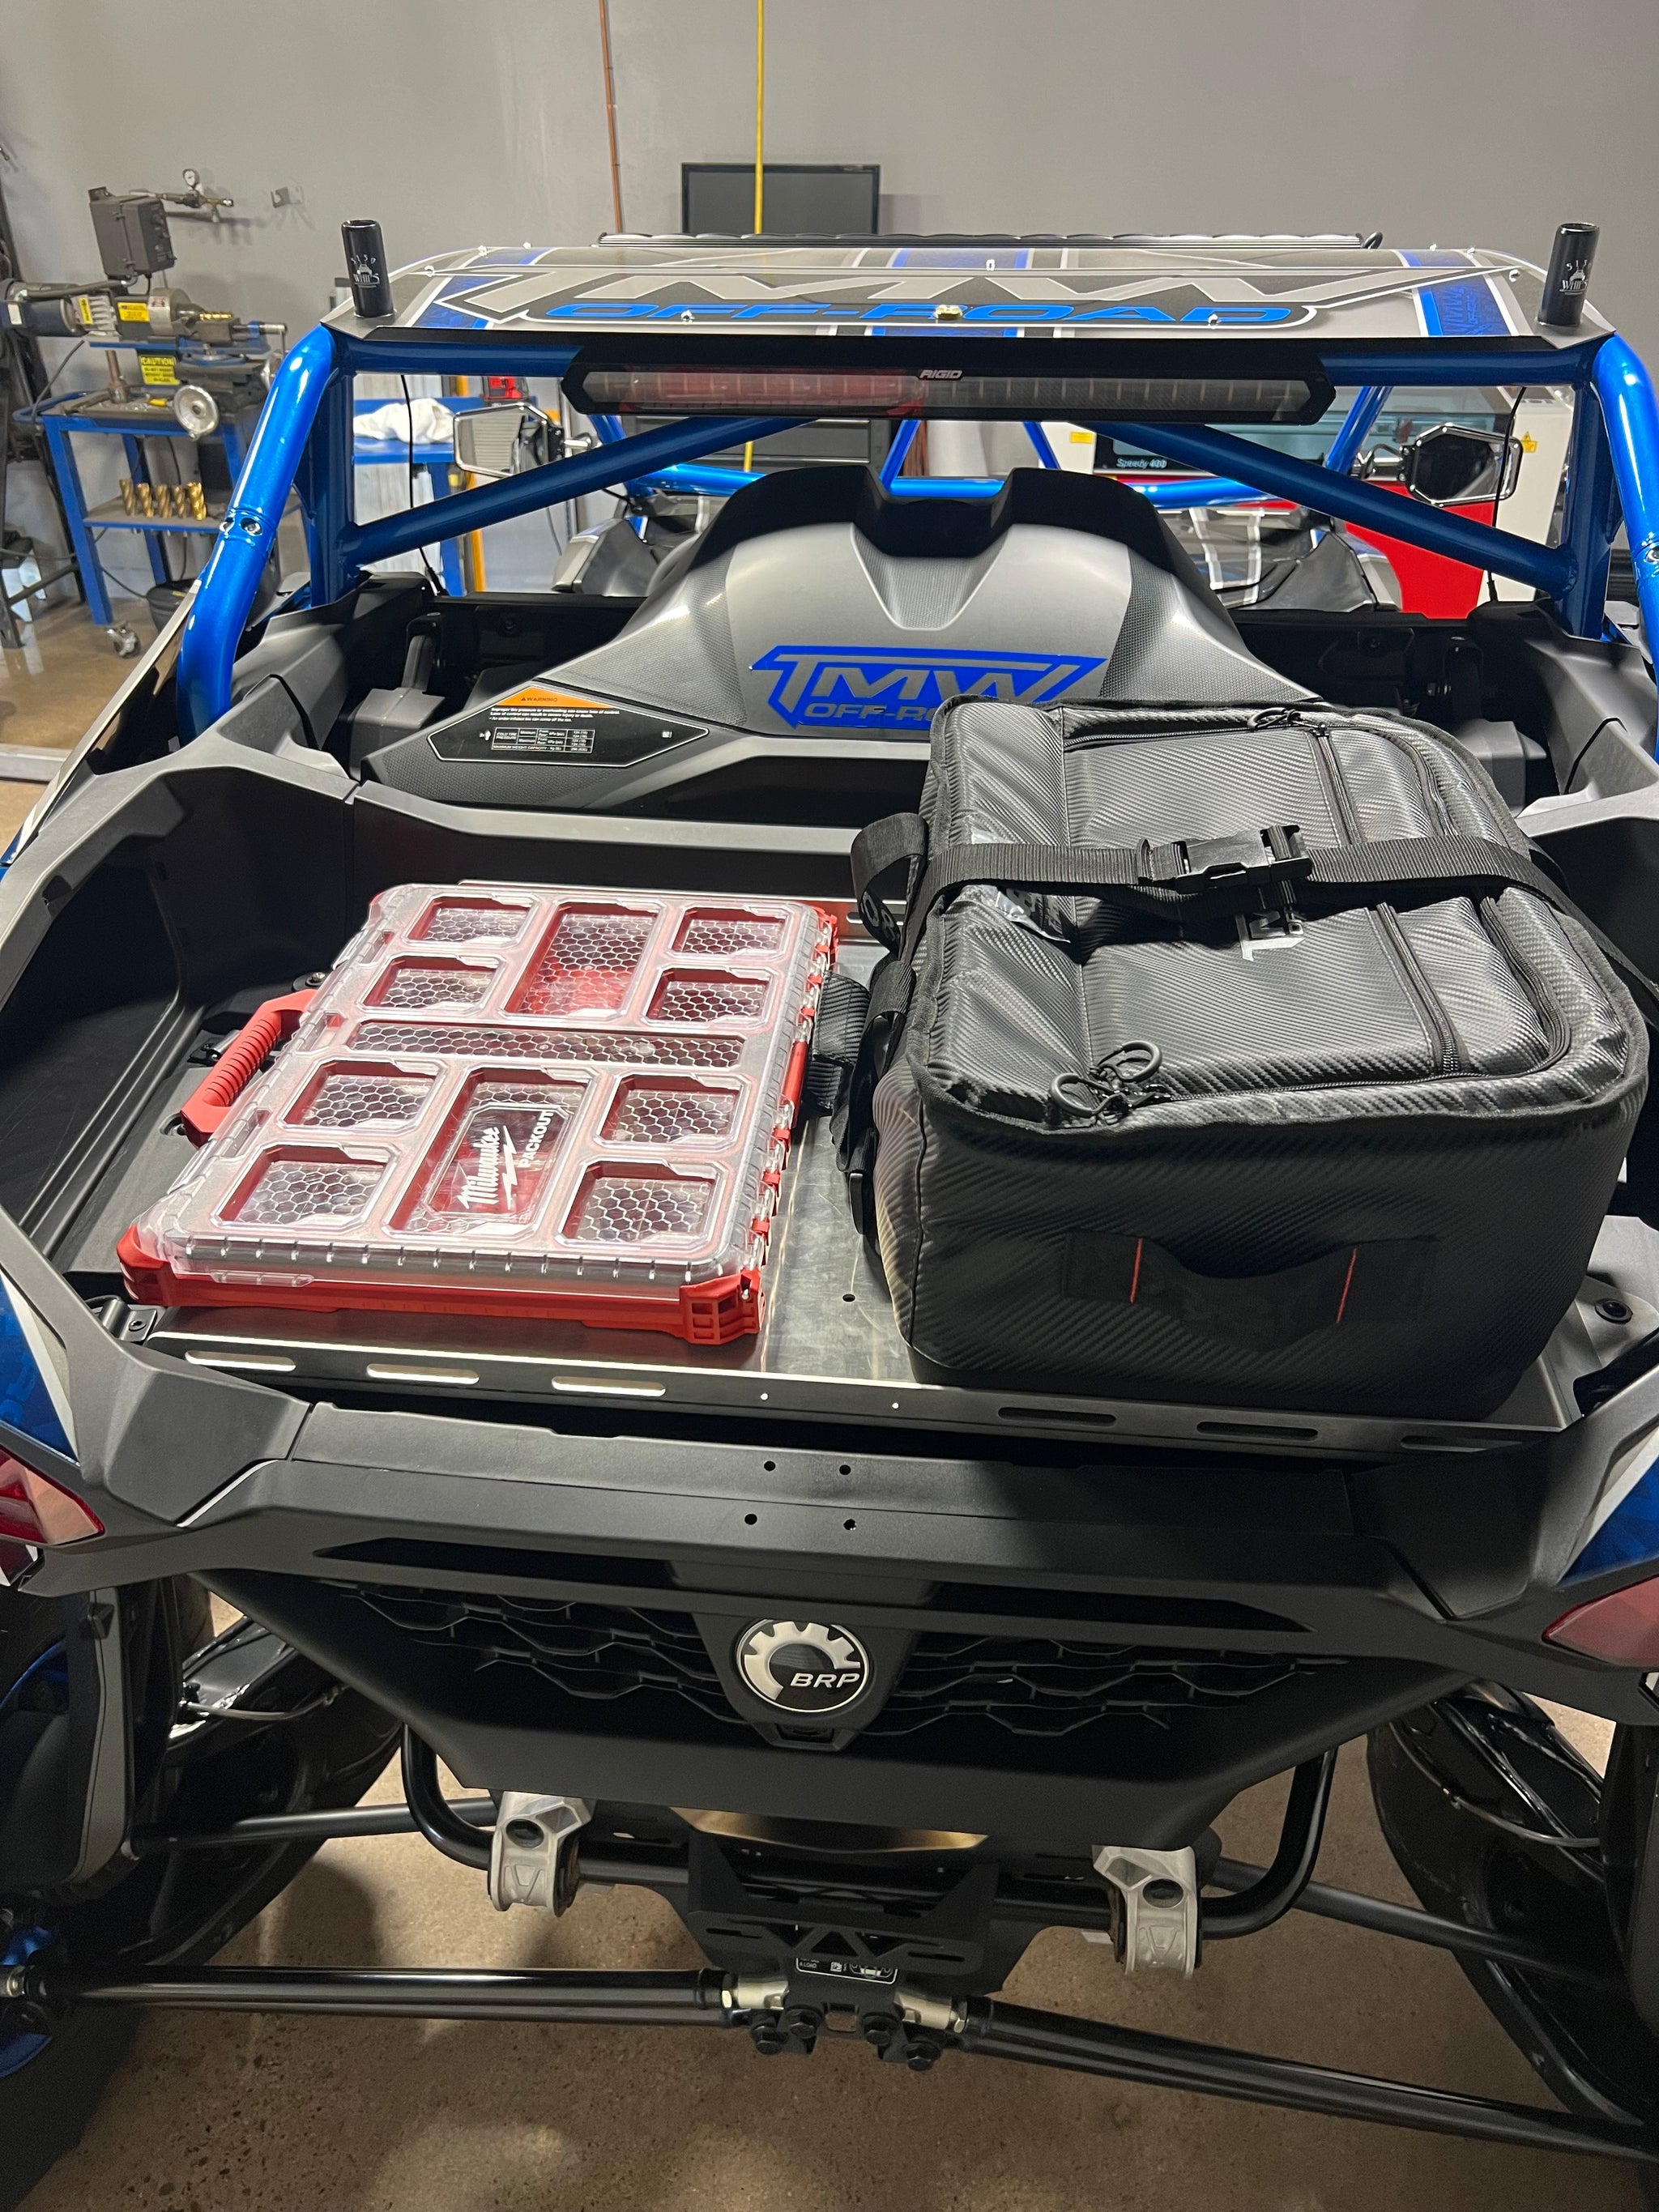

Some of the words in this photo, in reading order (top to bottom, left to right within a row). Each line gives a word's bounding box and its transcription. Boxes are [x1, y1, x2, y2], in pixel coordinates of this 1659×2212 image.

[546, 303, 1291, 322] OFF-ROAD
[919, 369, 963, 379] RIGID
[1116, 458, 1148, 470] Speedy
[774, 654, 1081, 714] TMW
[804, 703, 933, 721] OFF-R
[517, 1110, 554, 1168] PACKOUT
[457, 1126, 501, 1209] Milwaukee
[790, 1673, 860, 1688] BRP
